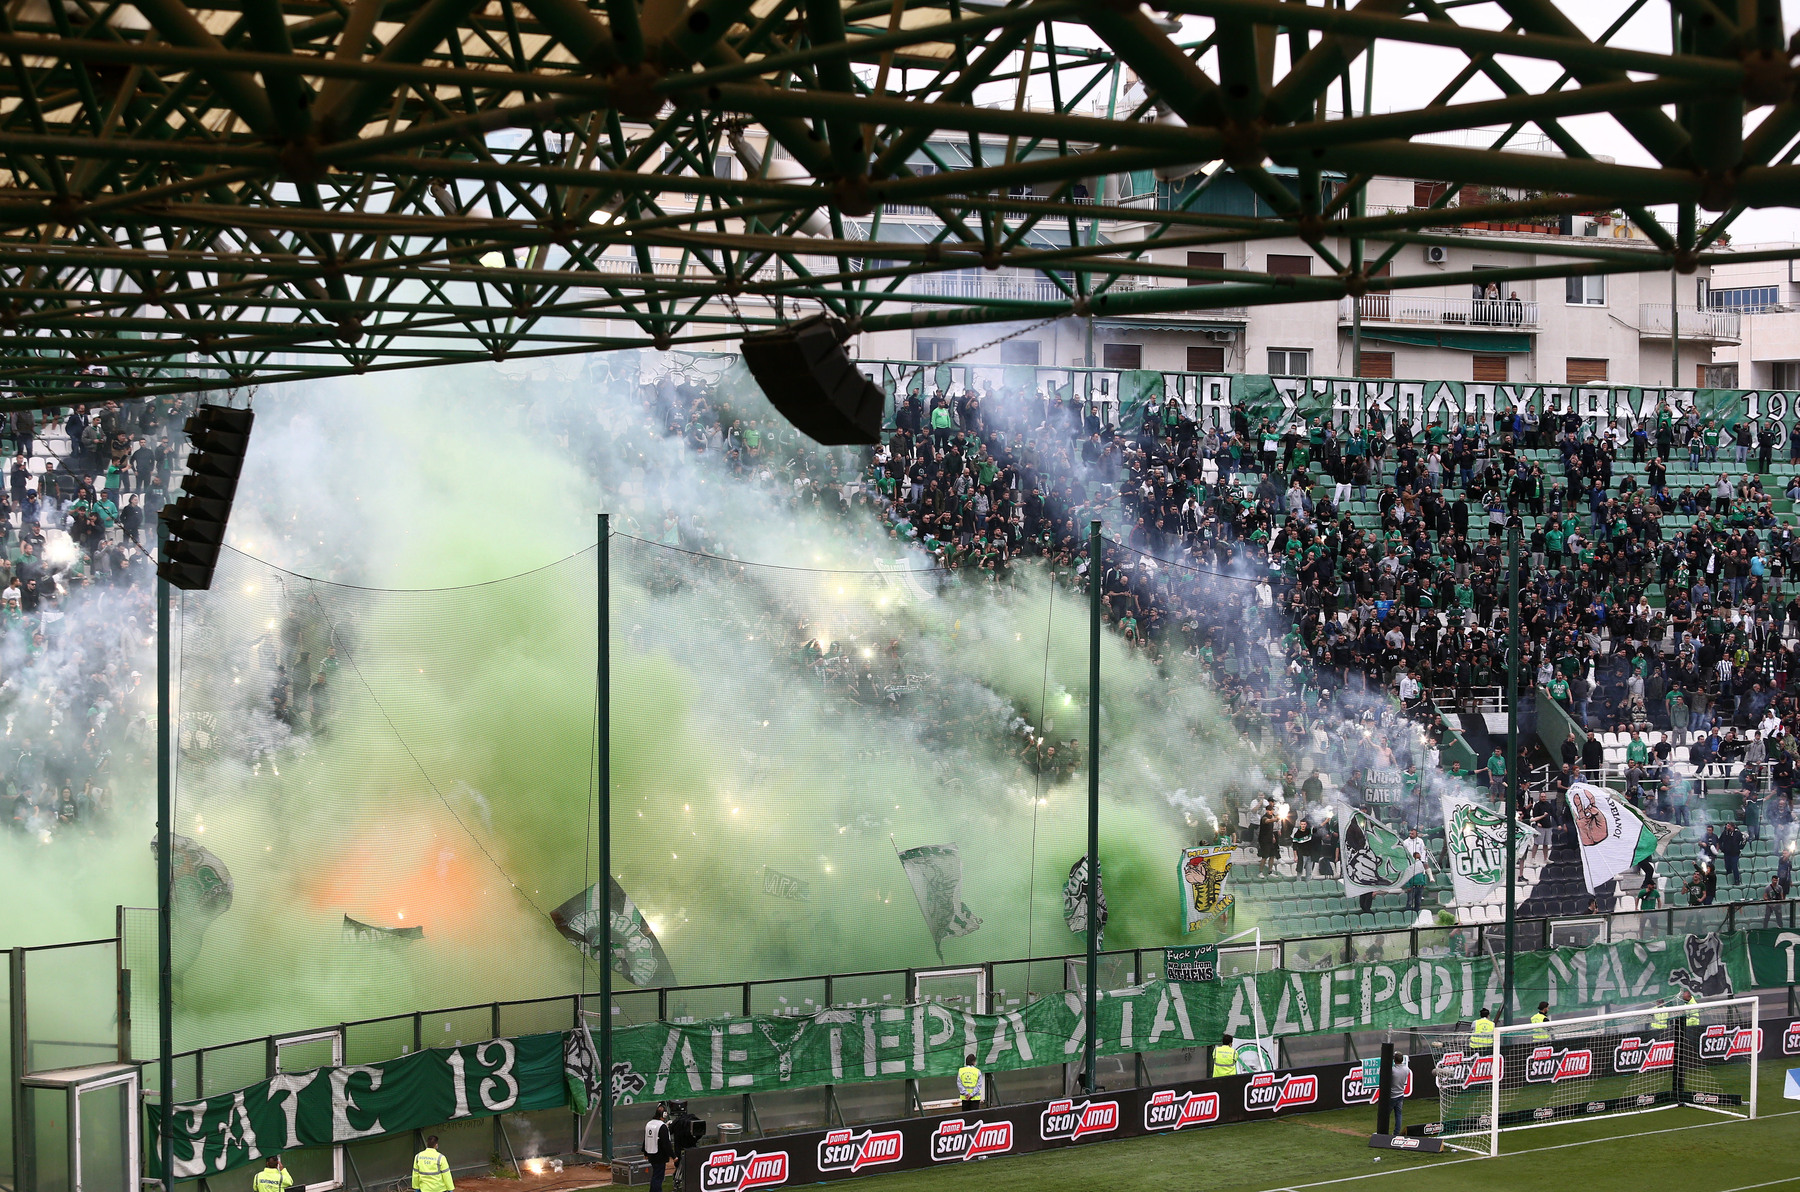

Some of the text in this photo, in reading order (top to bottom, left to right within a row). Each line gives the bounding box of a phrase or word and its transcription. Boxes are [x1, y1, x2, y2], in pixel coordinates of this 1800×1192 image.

[1365, 788, 1391, 803] GATE
[1167, 944, 1214, 960] Fuck you!
[1194, 961, 1212, 969] from
[1167, 968, 1213, 980] ATHENS
[1223, 959, 1522, 1036] ΑΔΕΡΦΙΑ
[1548, 940, 1666, 1007] ΜΑΣ
[1254, 1076, 1271, 1086] pame
[1154, 1094, 1172, 1104] pame
[157, 1038, 520, 1179] GATE 13
[1051, 1103, 1069, 1113] pame
[942, 1123, 961, 1133] pame
[830, 1133, 849, 1144] pame
[713, 1154, 734, 1165] pame
